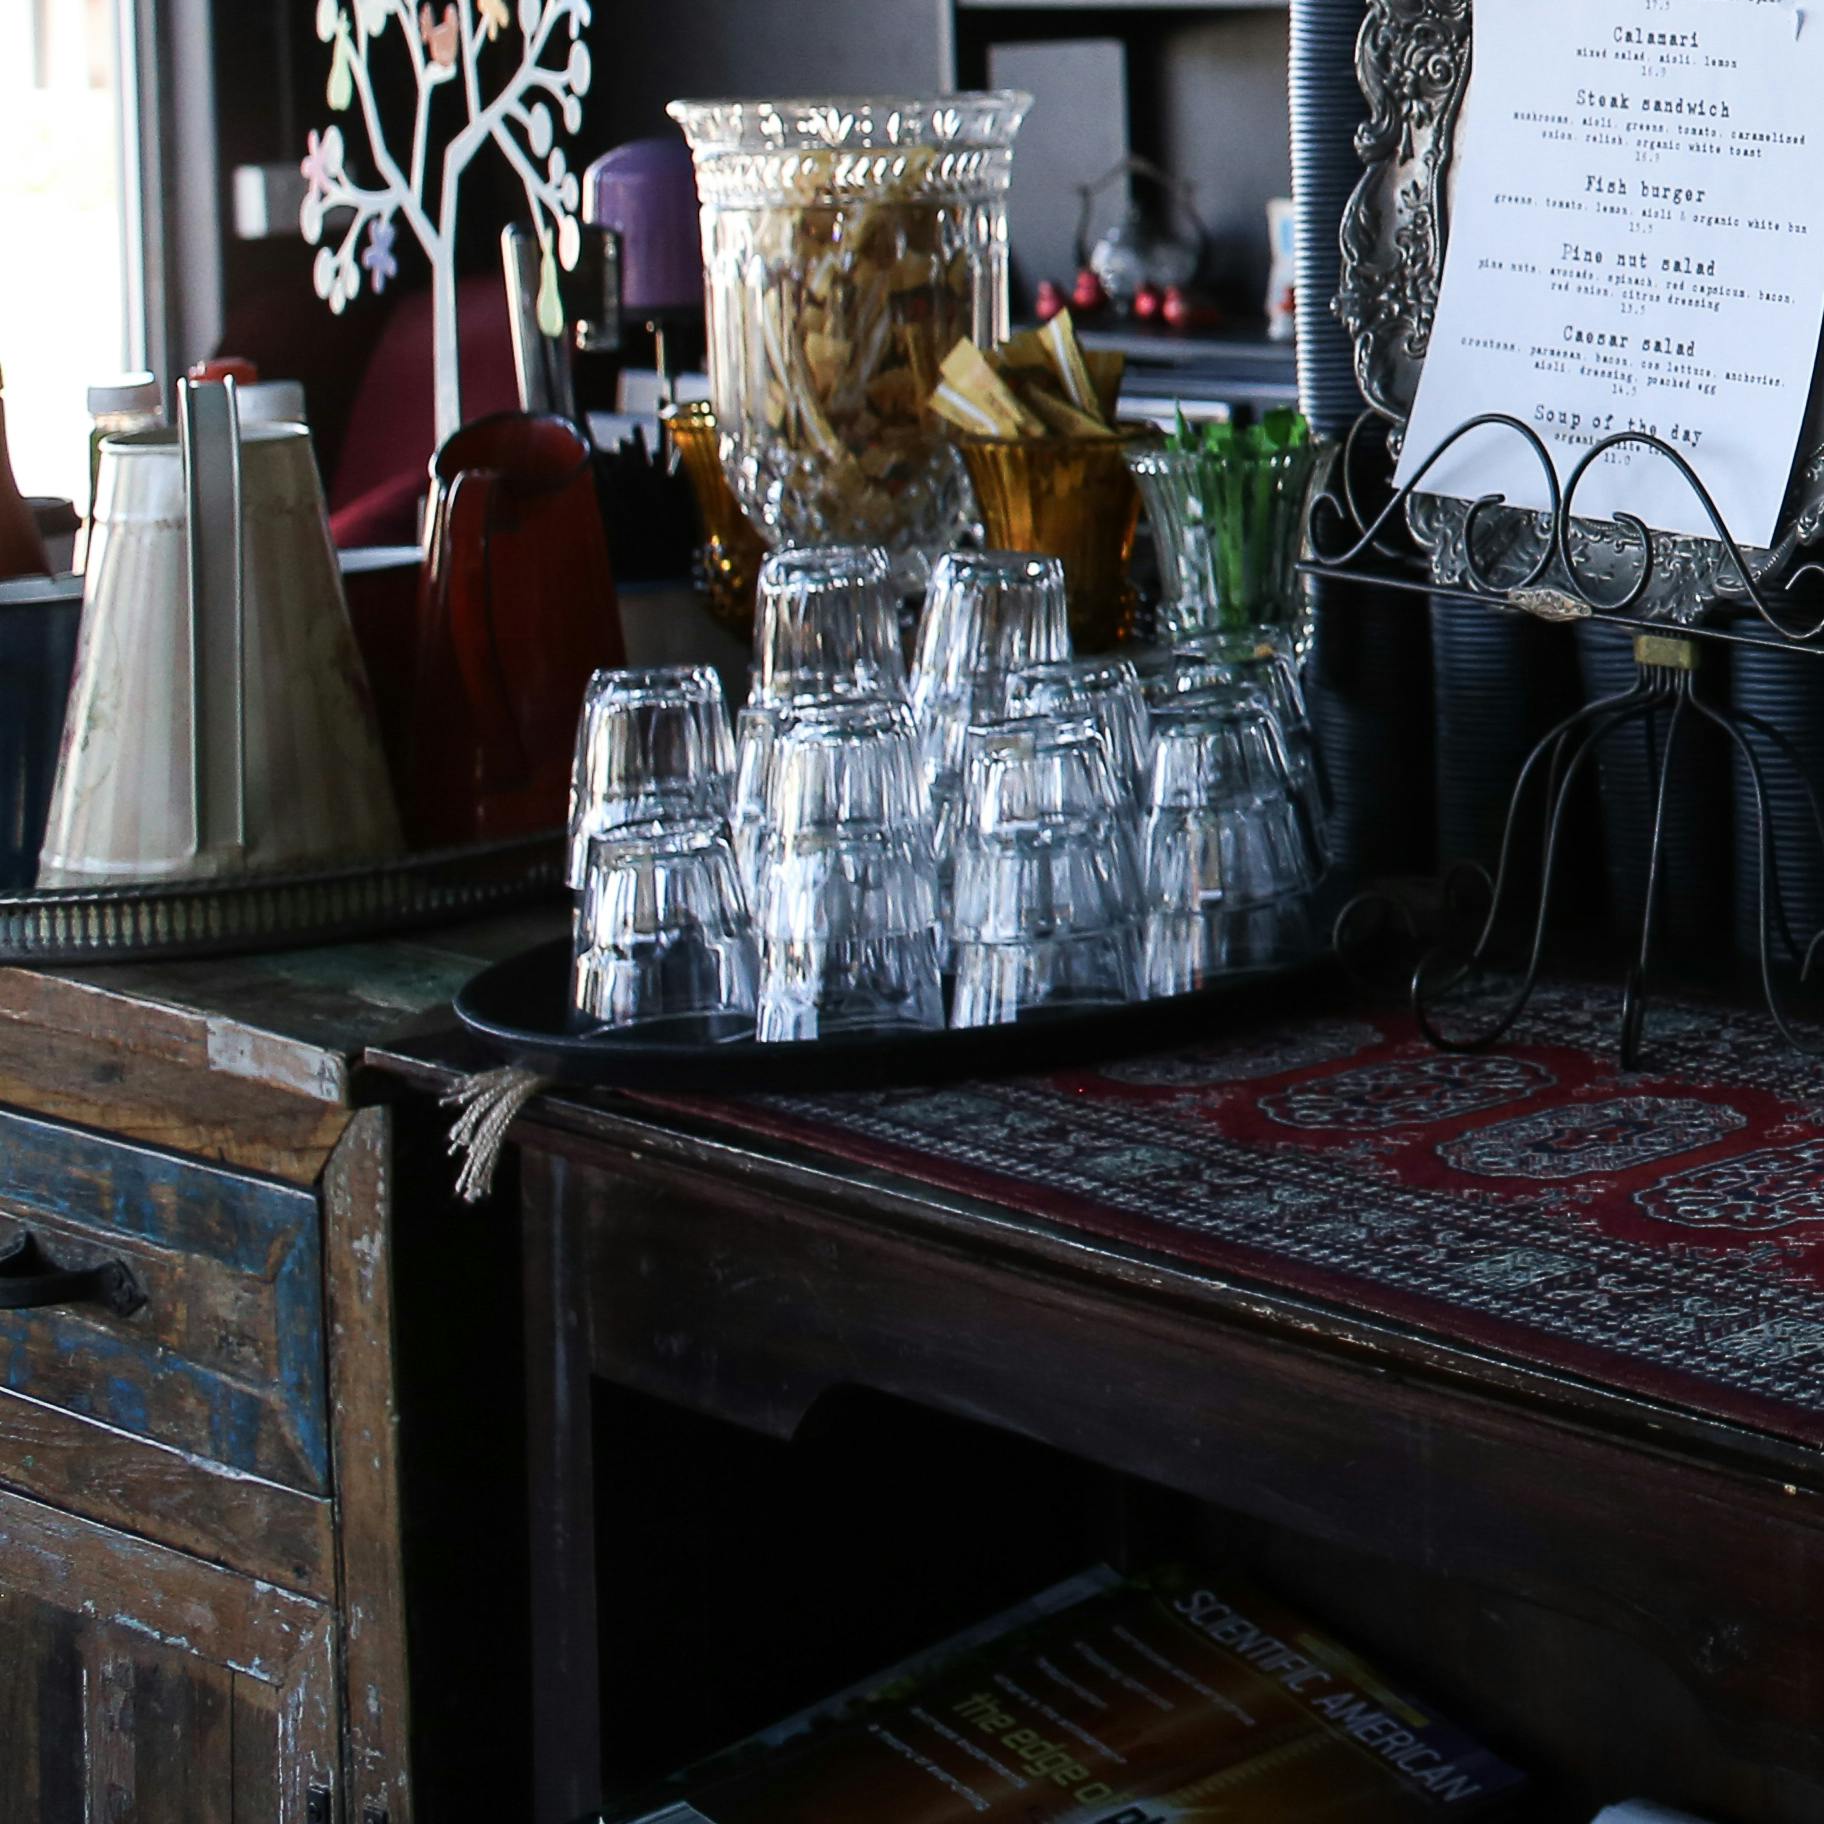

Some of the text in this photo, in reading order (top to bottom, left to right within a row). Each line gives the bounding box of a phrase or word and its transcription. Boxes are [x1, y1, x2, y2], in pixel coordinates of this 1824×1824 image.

[1613, 26, 1700, 48] Calamari
[1576, 46, 1607, 59] mixed
[1704, 55, 1738, 69] lemon
[1576, 89, 1731, 118] Steak sandwich
[1636, 137, 1681, 152] organic
[1688, 141, 1722, 155] white
[1729, 144, 1762, 159] toast
[1585, 174, 1706, 204] Fish burger
[1641, 206, 1672, 221] aioli
[1693, 213, 1740, 229] organic
[1747, 218, 1780, 232] white
[1788, 221, 1808, 235] bun
[1561, 243, 1716, 277] Pine nut salad
[1622, 288, 1660, 303] citrus
[1667, 294, 1721, 313] dressing
[1563, 325, 1695, 358] Caesar salad
[1647, 375, 1690, 391] poached
[1697, 381, 1716, 396] egg
[1534, 403, 1703, 448] Soup of the day
[1172, 1588, 1333, 1694] SCIENTIFIC
[1311, 1691, 1483, 1804] AMERICAN
[952, 1691, 1016, 1735] the
[1000, 1728, 1092, 1788] edge
